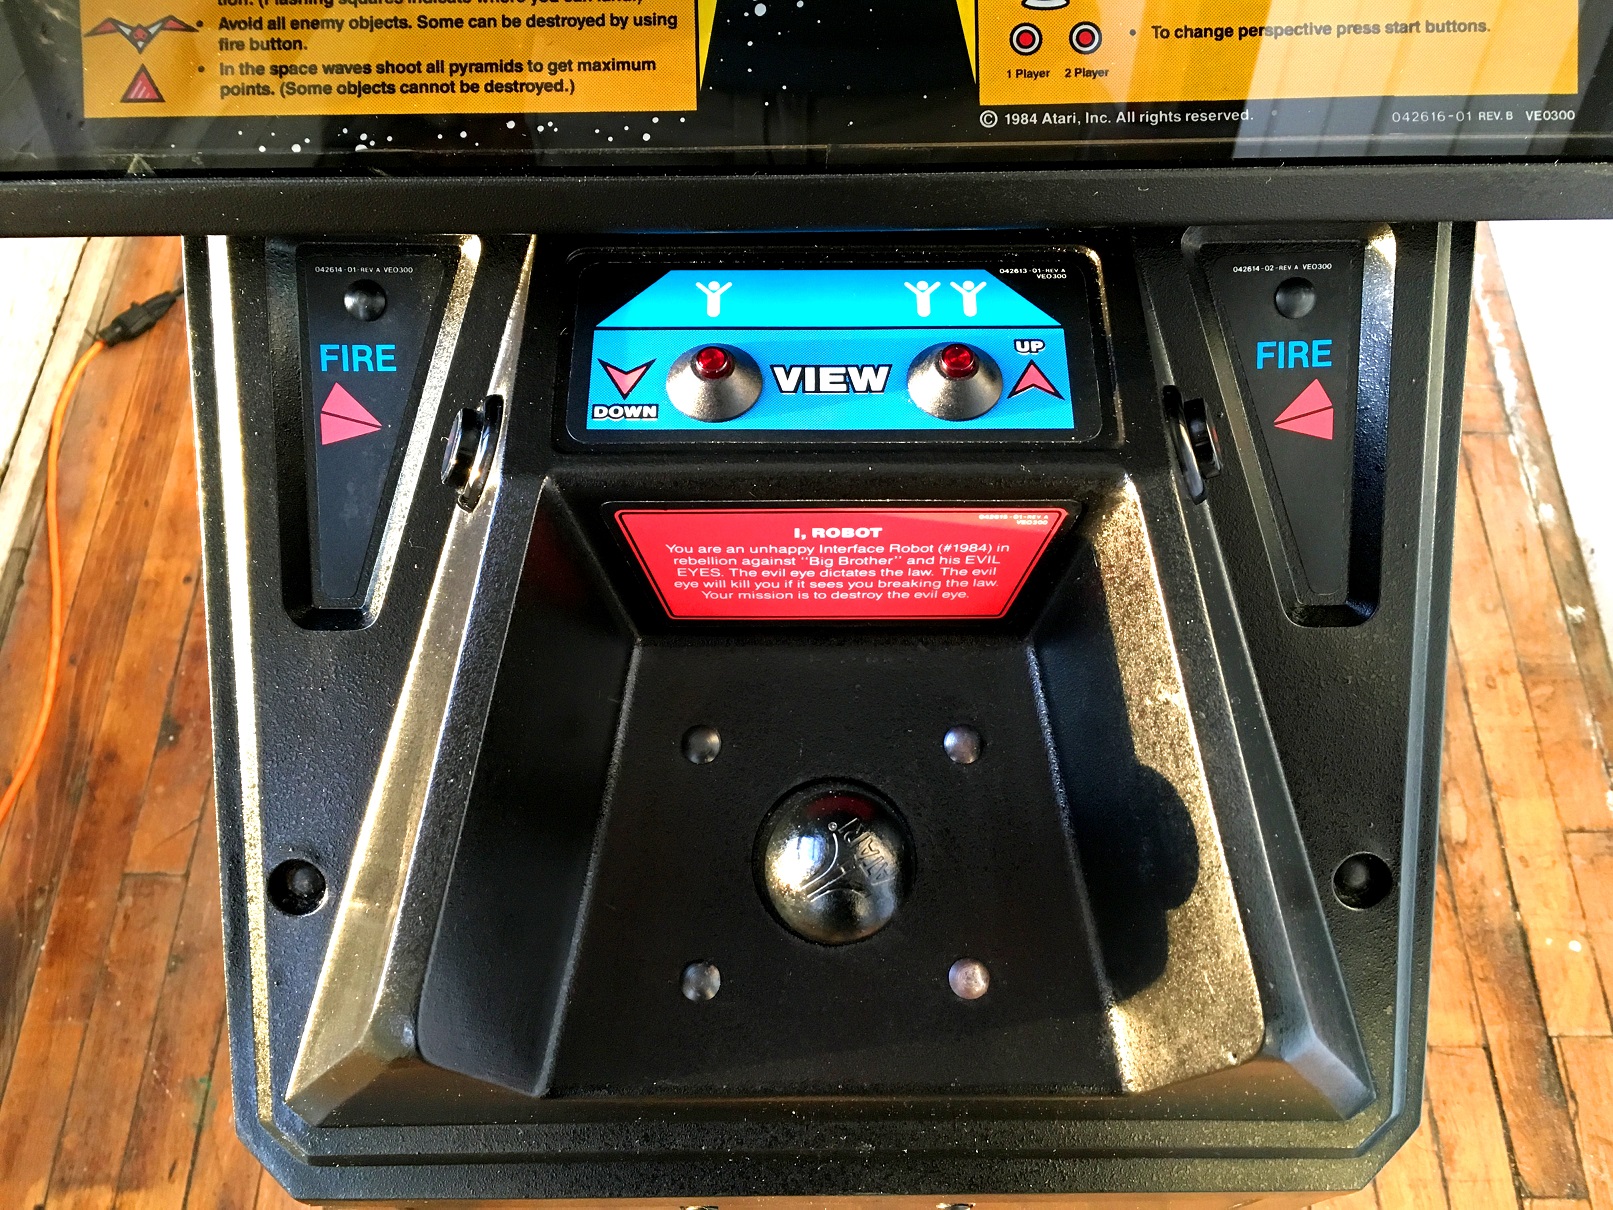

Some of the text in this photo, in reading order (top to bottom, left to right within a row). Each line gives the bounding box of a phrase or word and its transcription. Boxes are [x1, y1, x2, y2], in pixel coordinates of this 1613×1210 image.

[219, 13, 678, 32] Avoid all enemy objects. Some can be destroyed by using
[1151, 20, 1490, 41] To change perspective press start buttons.
[218, 37, 308, 51] fire button.
[220, 59, 656, 78] In the space waves shoot all pyramids to get maximum
[1007, 69, 1050, 80] 1 Player
[1065, 68, 1109, 79] 2 Player
[221, 79, 575, 99] points. (Some objects cannot be destroyed.)
[1004, 113, 1037, 124] 1984
[1042, 112, 1080, 126] Atari,
[1085, 111, 1111, 123] Inc.
[1116, 111, 1135, 123] All
[1140, 110, 1181, 125] rights
[1186, 108, 1253, 122] reserved.
[1392, 111, 1471, 122] 042616-01
[1014, 339, 1046, 354] UP
[320, 344, 397, 371] FIRE
[1257, 340, 1332, 369] FIRE
[770, 364, 892, 393] VIEW
[591, 403, 658, 419] DOWN
[794, 528, 882, 540] I, ROBOT
[666, 544, 693, 553] You
[750, 545, 815, 555] unhappy
[820, 544, 884, 553] Interface
[889, 544, 934, 553] Robot
[938, 544, 992, 554] (#1984)
[997, 544, 1009, 552] in
[674, 557, 737, 565] rebellion
[742, 557, 796, 567] against
[907, 556, 935, 564] and
[940, 556, 960, 564] his
[965, 556, 1000, 564] EVIL
[677, 568, 724, 577] EYES.
[729, 568, 757, 577] The
[762, 569, 785, 577] evil
[790, 570, 815, 579] eye
[820, 568, 876, 577] dictates
[881, 568, 903, 576] the
[908, 568, 934, 576] law.
[674, 581, 699, 589] eye
[703, 580, 726, 588] will
[731, 580, 750, 588] kill
[754, 581, 780, 589] you
[784, 580, 793, 588] if
[798, 580, 805, 588] it
[848, 581, 873, 589] you
[878, 579, 941, 589] breaking
[946, 579, 968, 587] the
[973, 579, 998, 587] law.
[702, 591, 733, 599] Your
[738, 591, 793, 599] mission
[798, 591, 809, 599] is
[831, 591, 883, 600] destroy
[888, 591, 910, 599] the
[914, 590, 938, 598] evil
[942, 591, 969, 600] eye.
